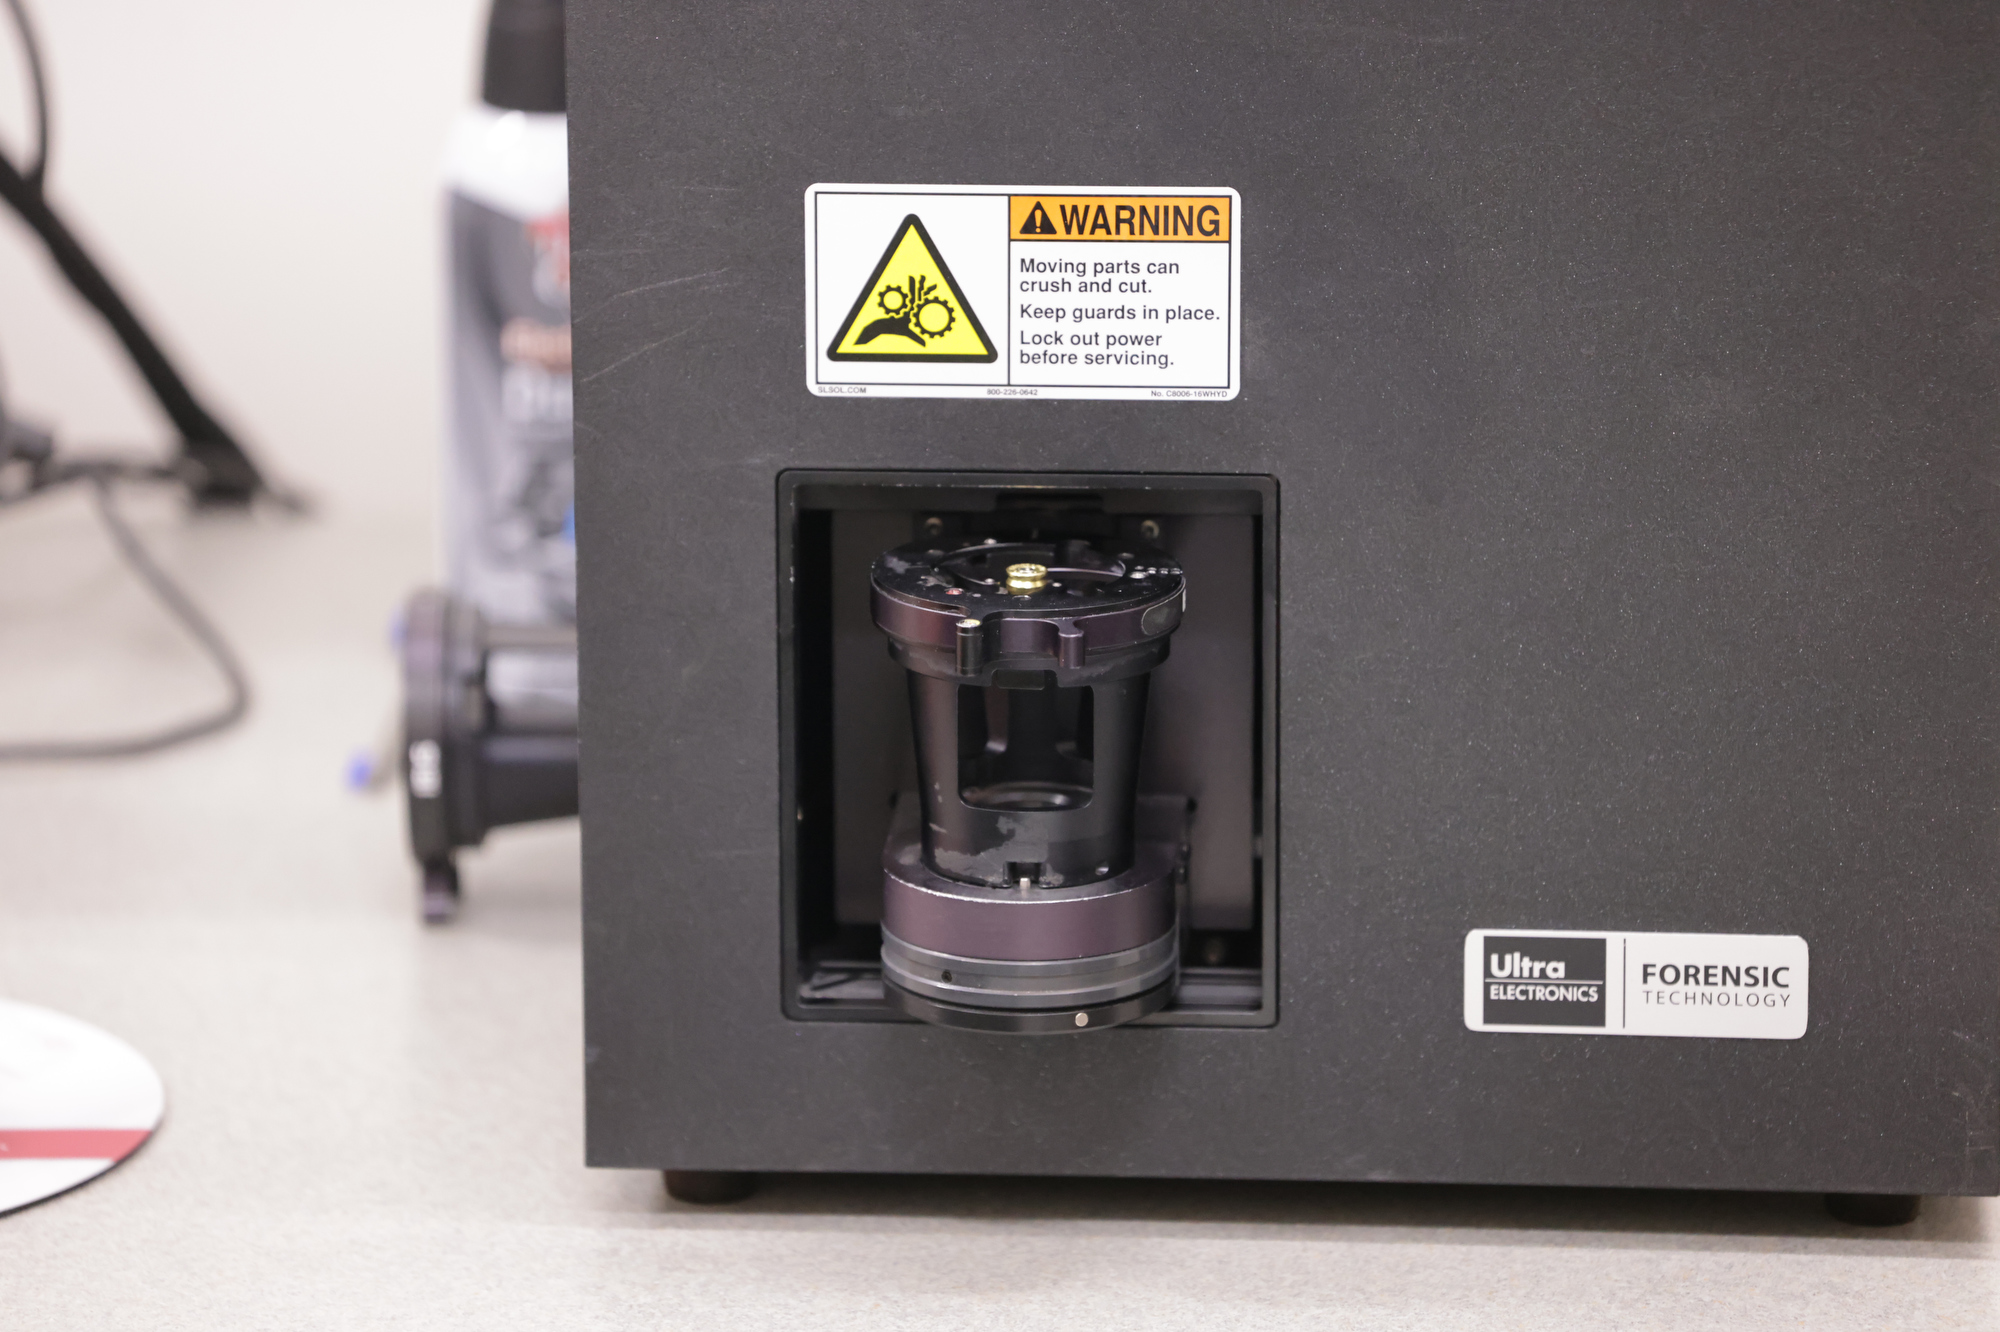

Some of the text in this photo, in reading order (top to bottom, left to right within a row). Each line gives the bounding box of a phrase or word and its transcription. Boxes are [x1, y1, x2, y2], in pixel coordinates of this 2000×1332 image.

[1060, 205, 1219, 236] WARNING
[1020, 258, 1180, 276] Moving parts can
[1020, 278, 1151, 293] crush and cut.
[1021, 304, 1219, 323] Keep guards in place.
[1021, 331, 1162, 349] Lock out power
[1021, 350, 1174, 370] before servicing.
[818, 386, 867, 394] SLSOL.COM
[986, 388, 1038, 396] 800-226-0642
[1491, 952, 1565, 978] Ultra
[1643, 964, 1789, 988] FORENSIC
[1490, 985, 1598, 1002] ELECTRONICS
[1642, 990, 1790, 1008] TECHNOLOGY
